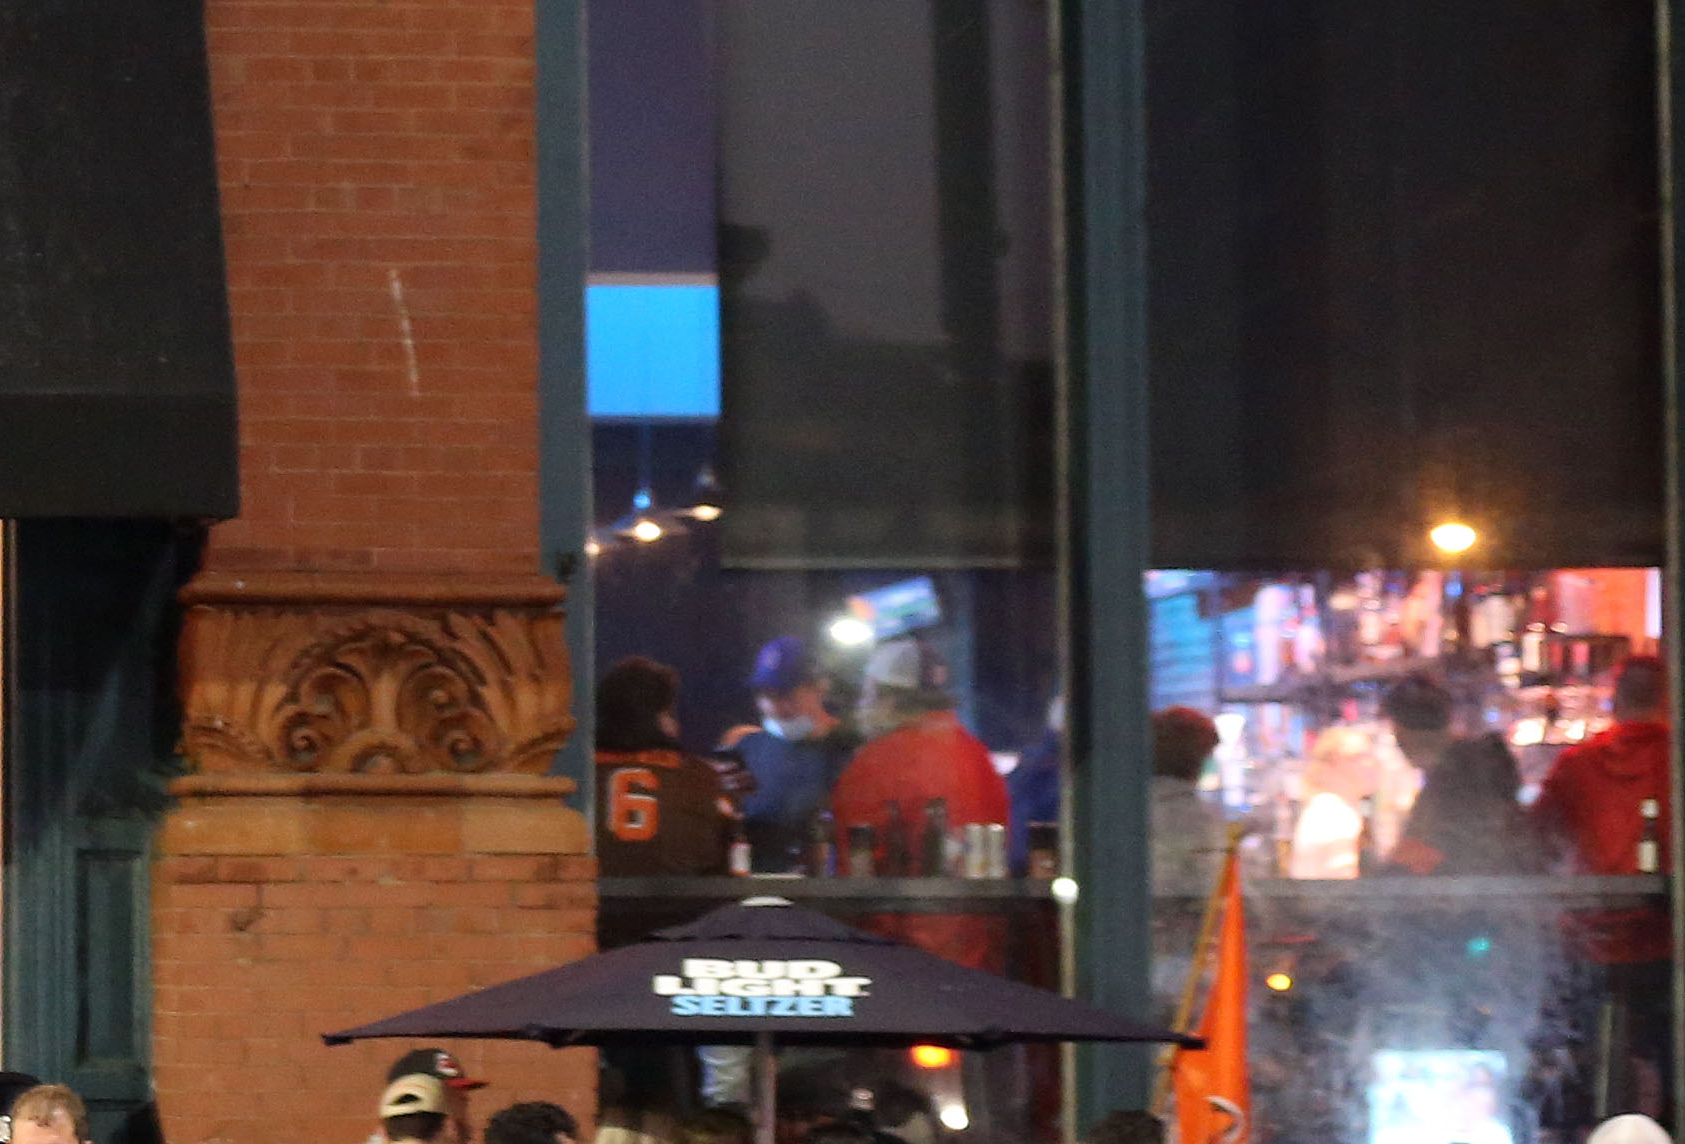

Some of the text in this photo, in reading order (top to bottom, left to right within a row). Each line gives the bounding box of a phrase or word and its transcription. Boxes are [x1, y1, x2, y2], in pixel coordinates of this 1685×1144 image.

[608, 766, 659, 841] 6
[683, 958, 843, 979] BUD
[653, 975, 873, 997] LIGHT
[670, 995, 855, 1018] SELTZER
